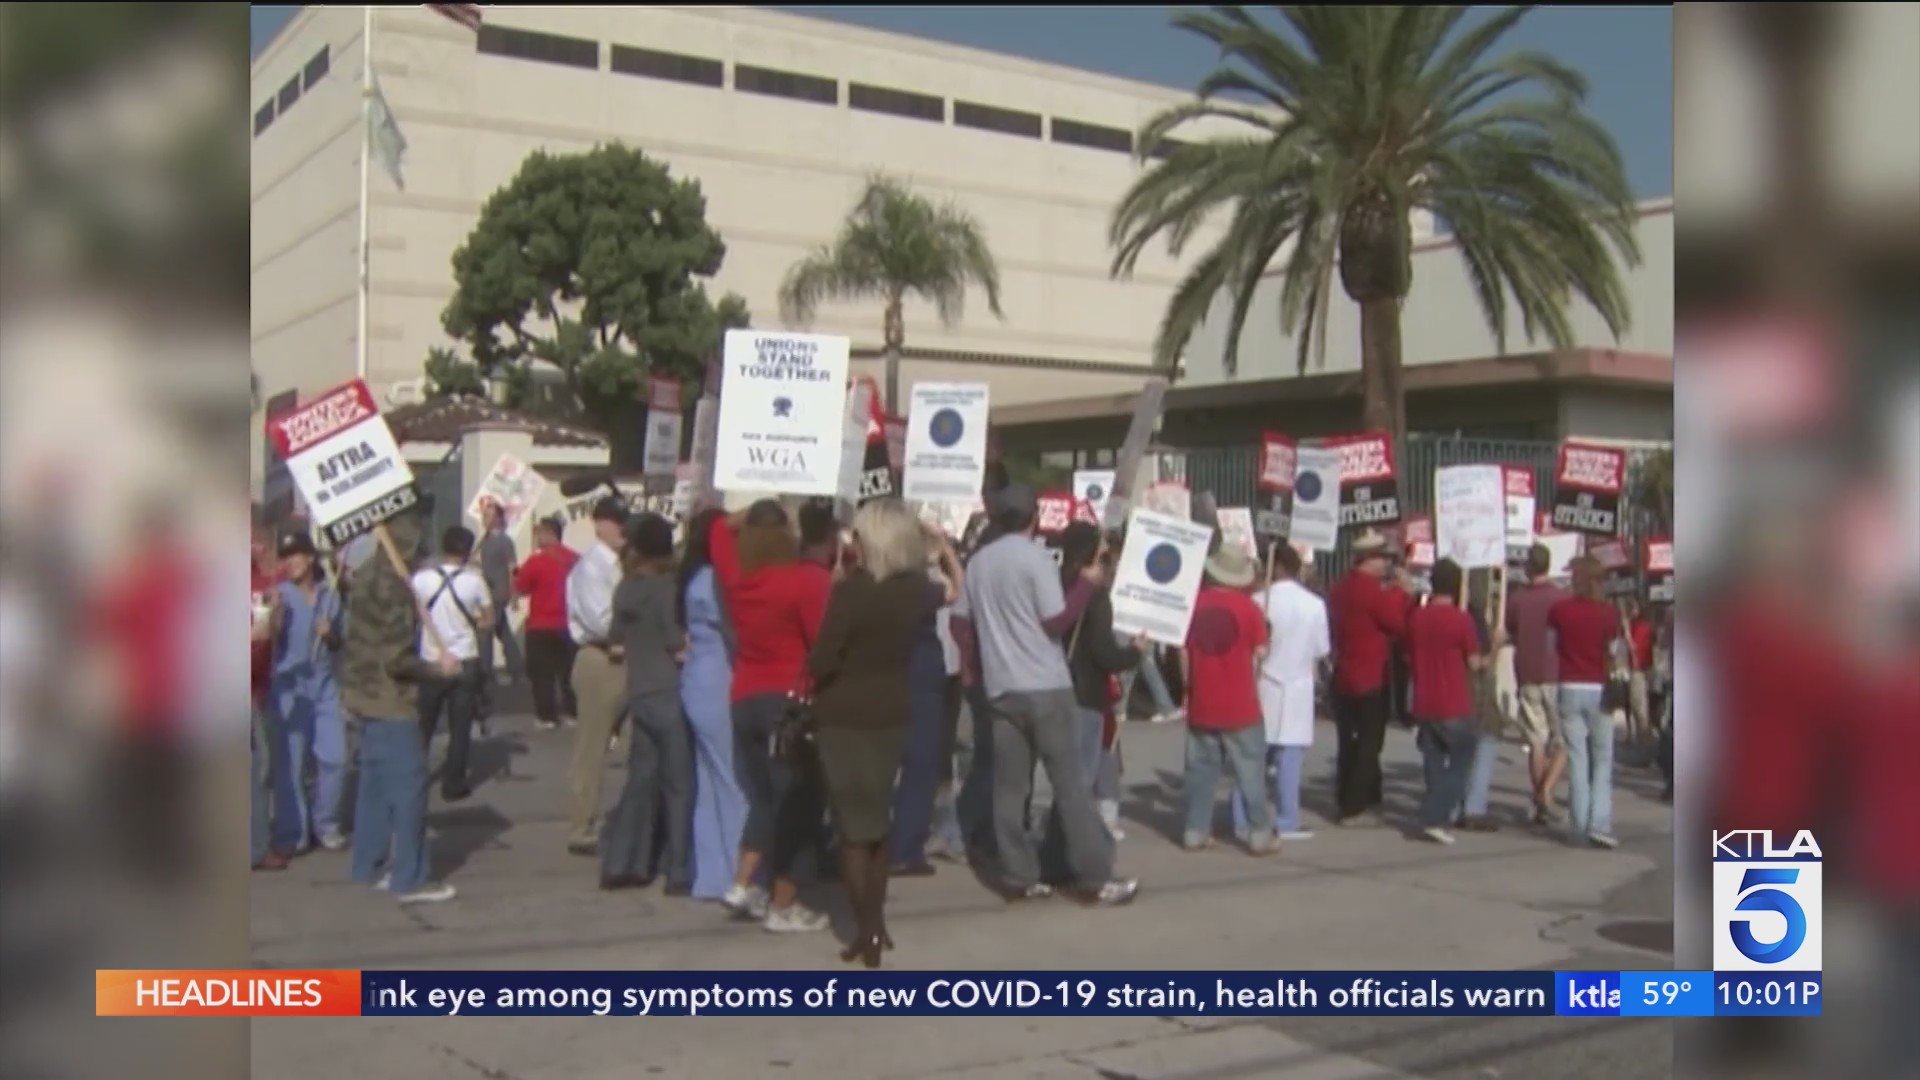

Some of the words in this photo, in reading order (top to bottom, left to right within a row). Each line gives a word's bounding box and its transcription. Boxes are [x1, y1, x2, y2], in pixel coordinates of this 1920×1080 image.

[754, 337, 819, 352] UNIONS
[758, 351, 813, 366] STAND
[740, 365, 831, 382] TOGETHER
[317, 440, 377, 483] AFTRA
[748, 446, 807, 470] WGA
